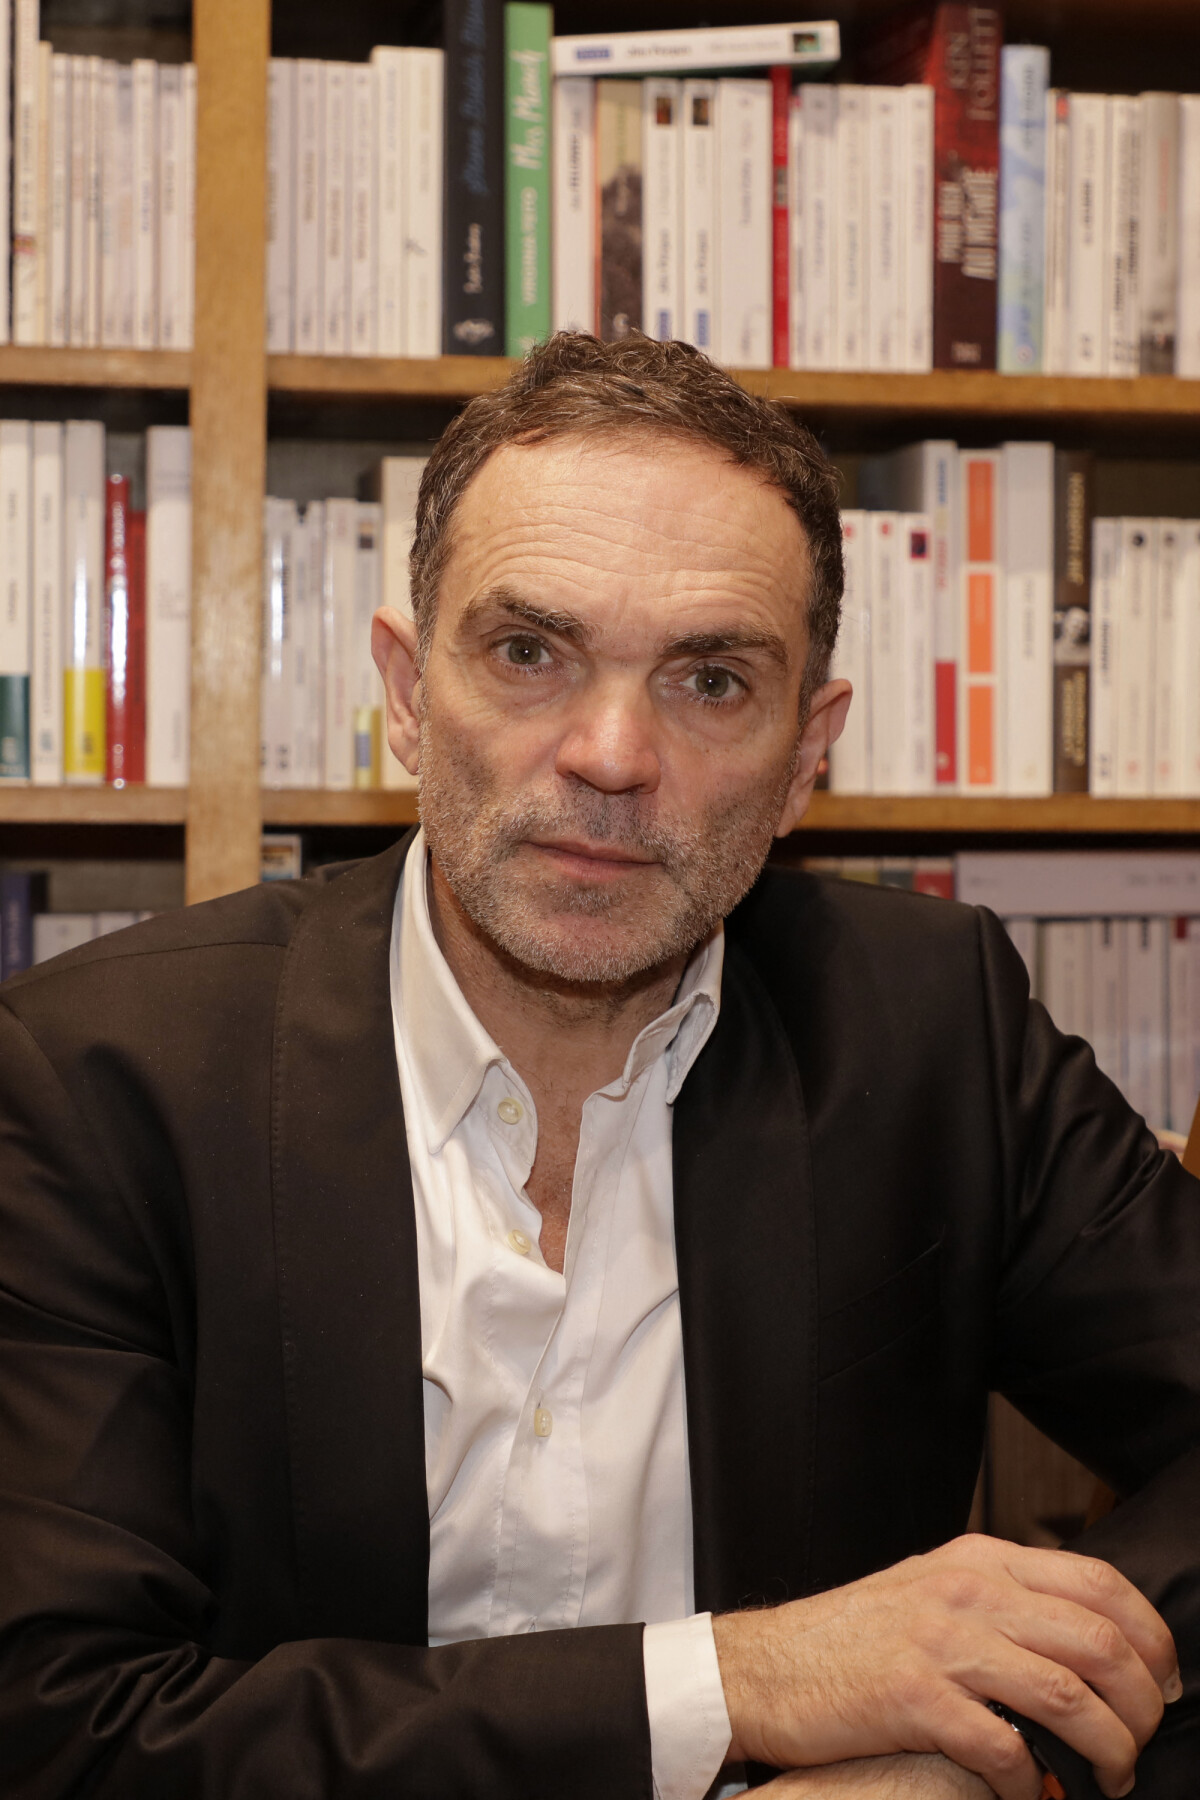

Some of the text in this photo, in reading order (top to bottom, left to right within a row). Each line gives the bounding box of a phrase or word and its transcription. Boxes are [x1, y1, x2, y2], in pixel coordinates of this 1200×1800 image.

[510, 49, 544, 169] Mrs March
[947, 33, 969, 88] KEN
[968, 7, 997, 121] FOLLETT
[520, 187, 538, 306] VIRGINIA FEITO
[939, 182, 962, 262] POUR RIEN
[962, 167, 997, 279] AU MONDE
